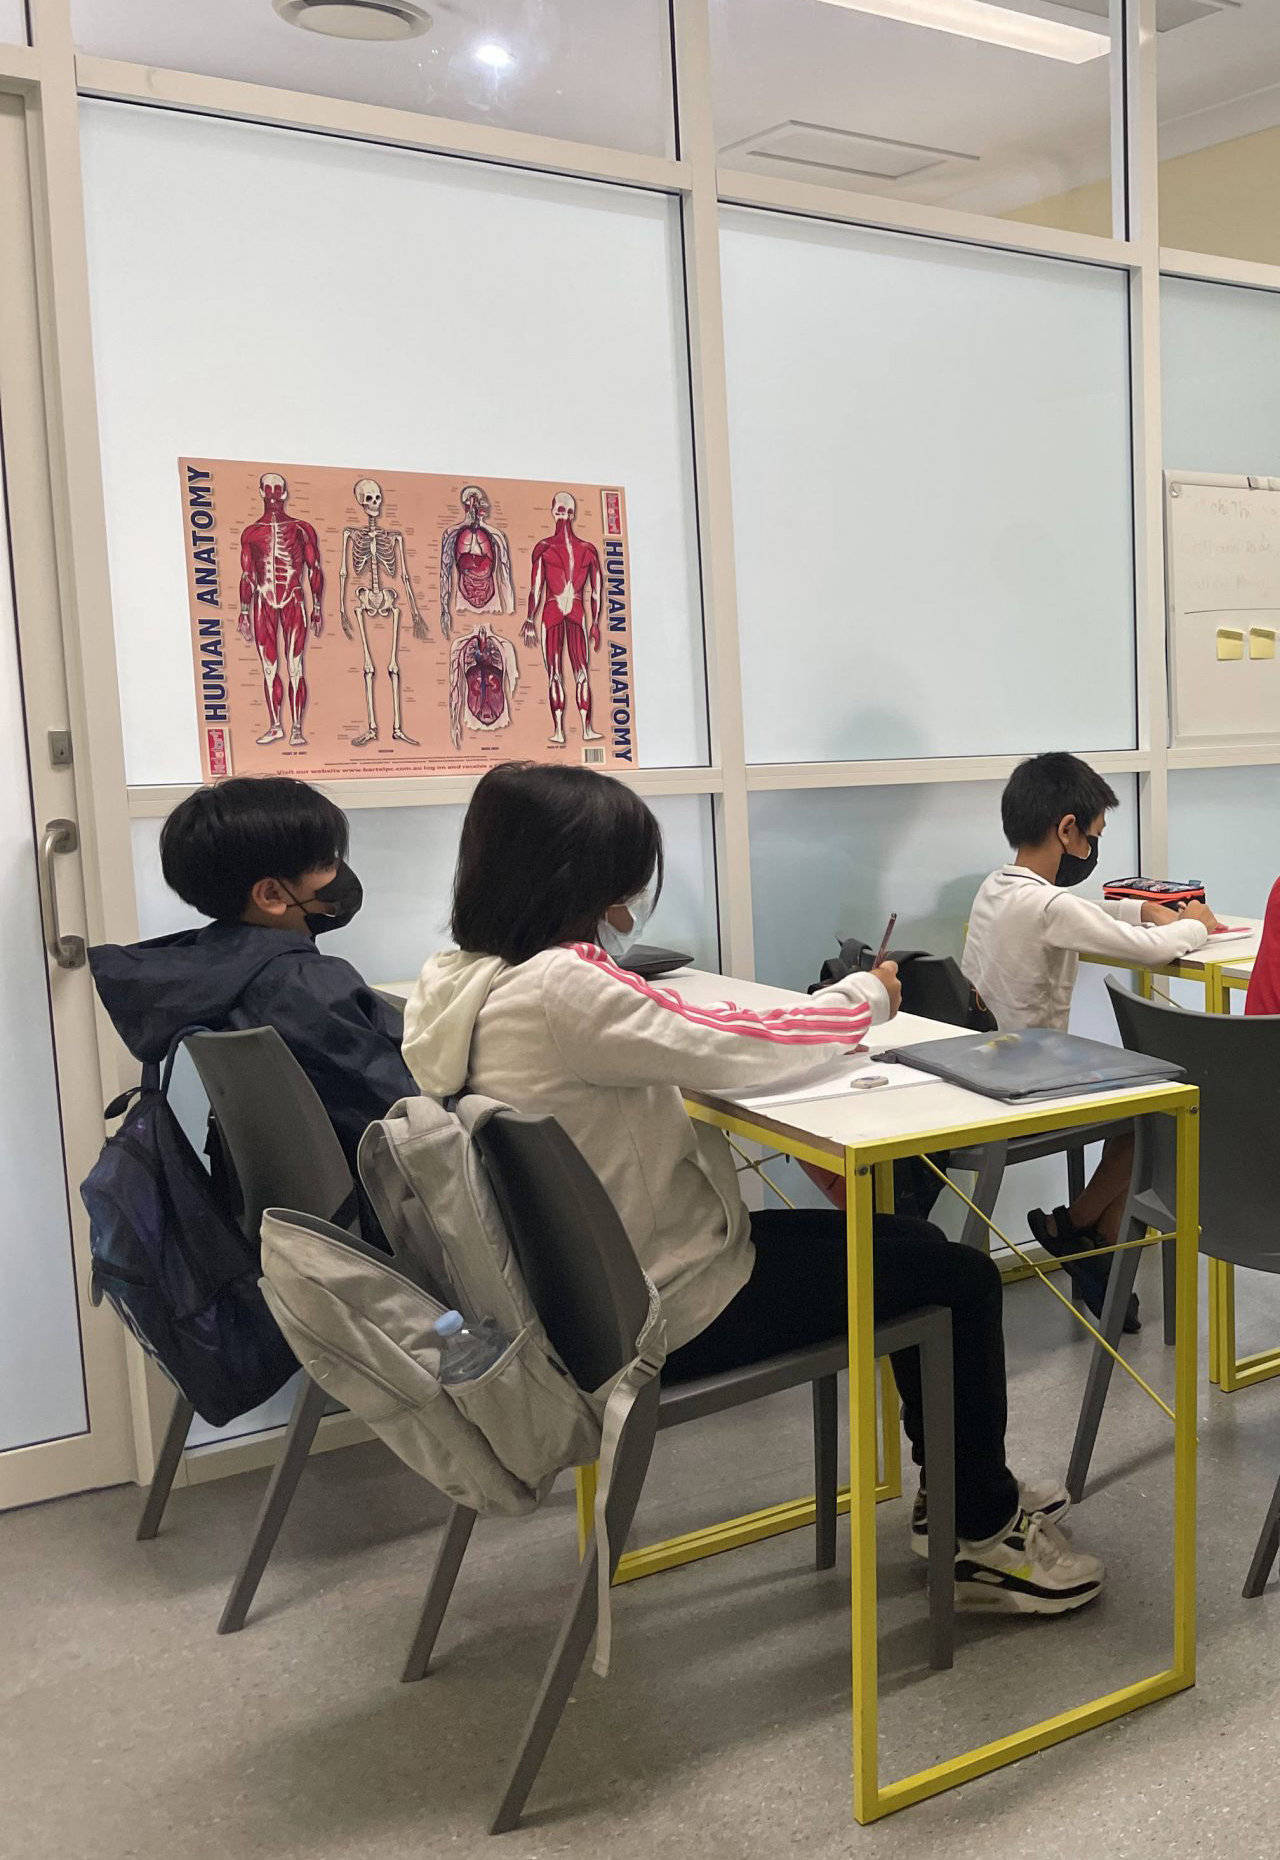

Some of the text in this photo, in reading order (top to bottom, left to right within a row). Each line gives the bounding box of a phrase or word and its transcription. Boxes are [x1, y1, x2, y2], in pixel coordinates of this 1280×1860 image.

[186, 465, 220, 607] ANATOMY
[605, 541, 627, 632] HUMAN
[197, 618, 228, 721] HUMAN
[609, 642, 633, 763] ANATOMY
